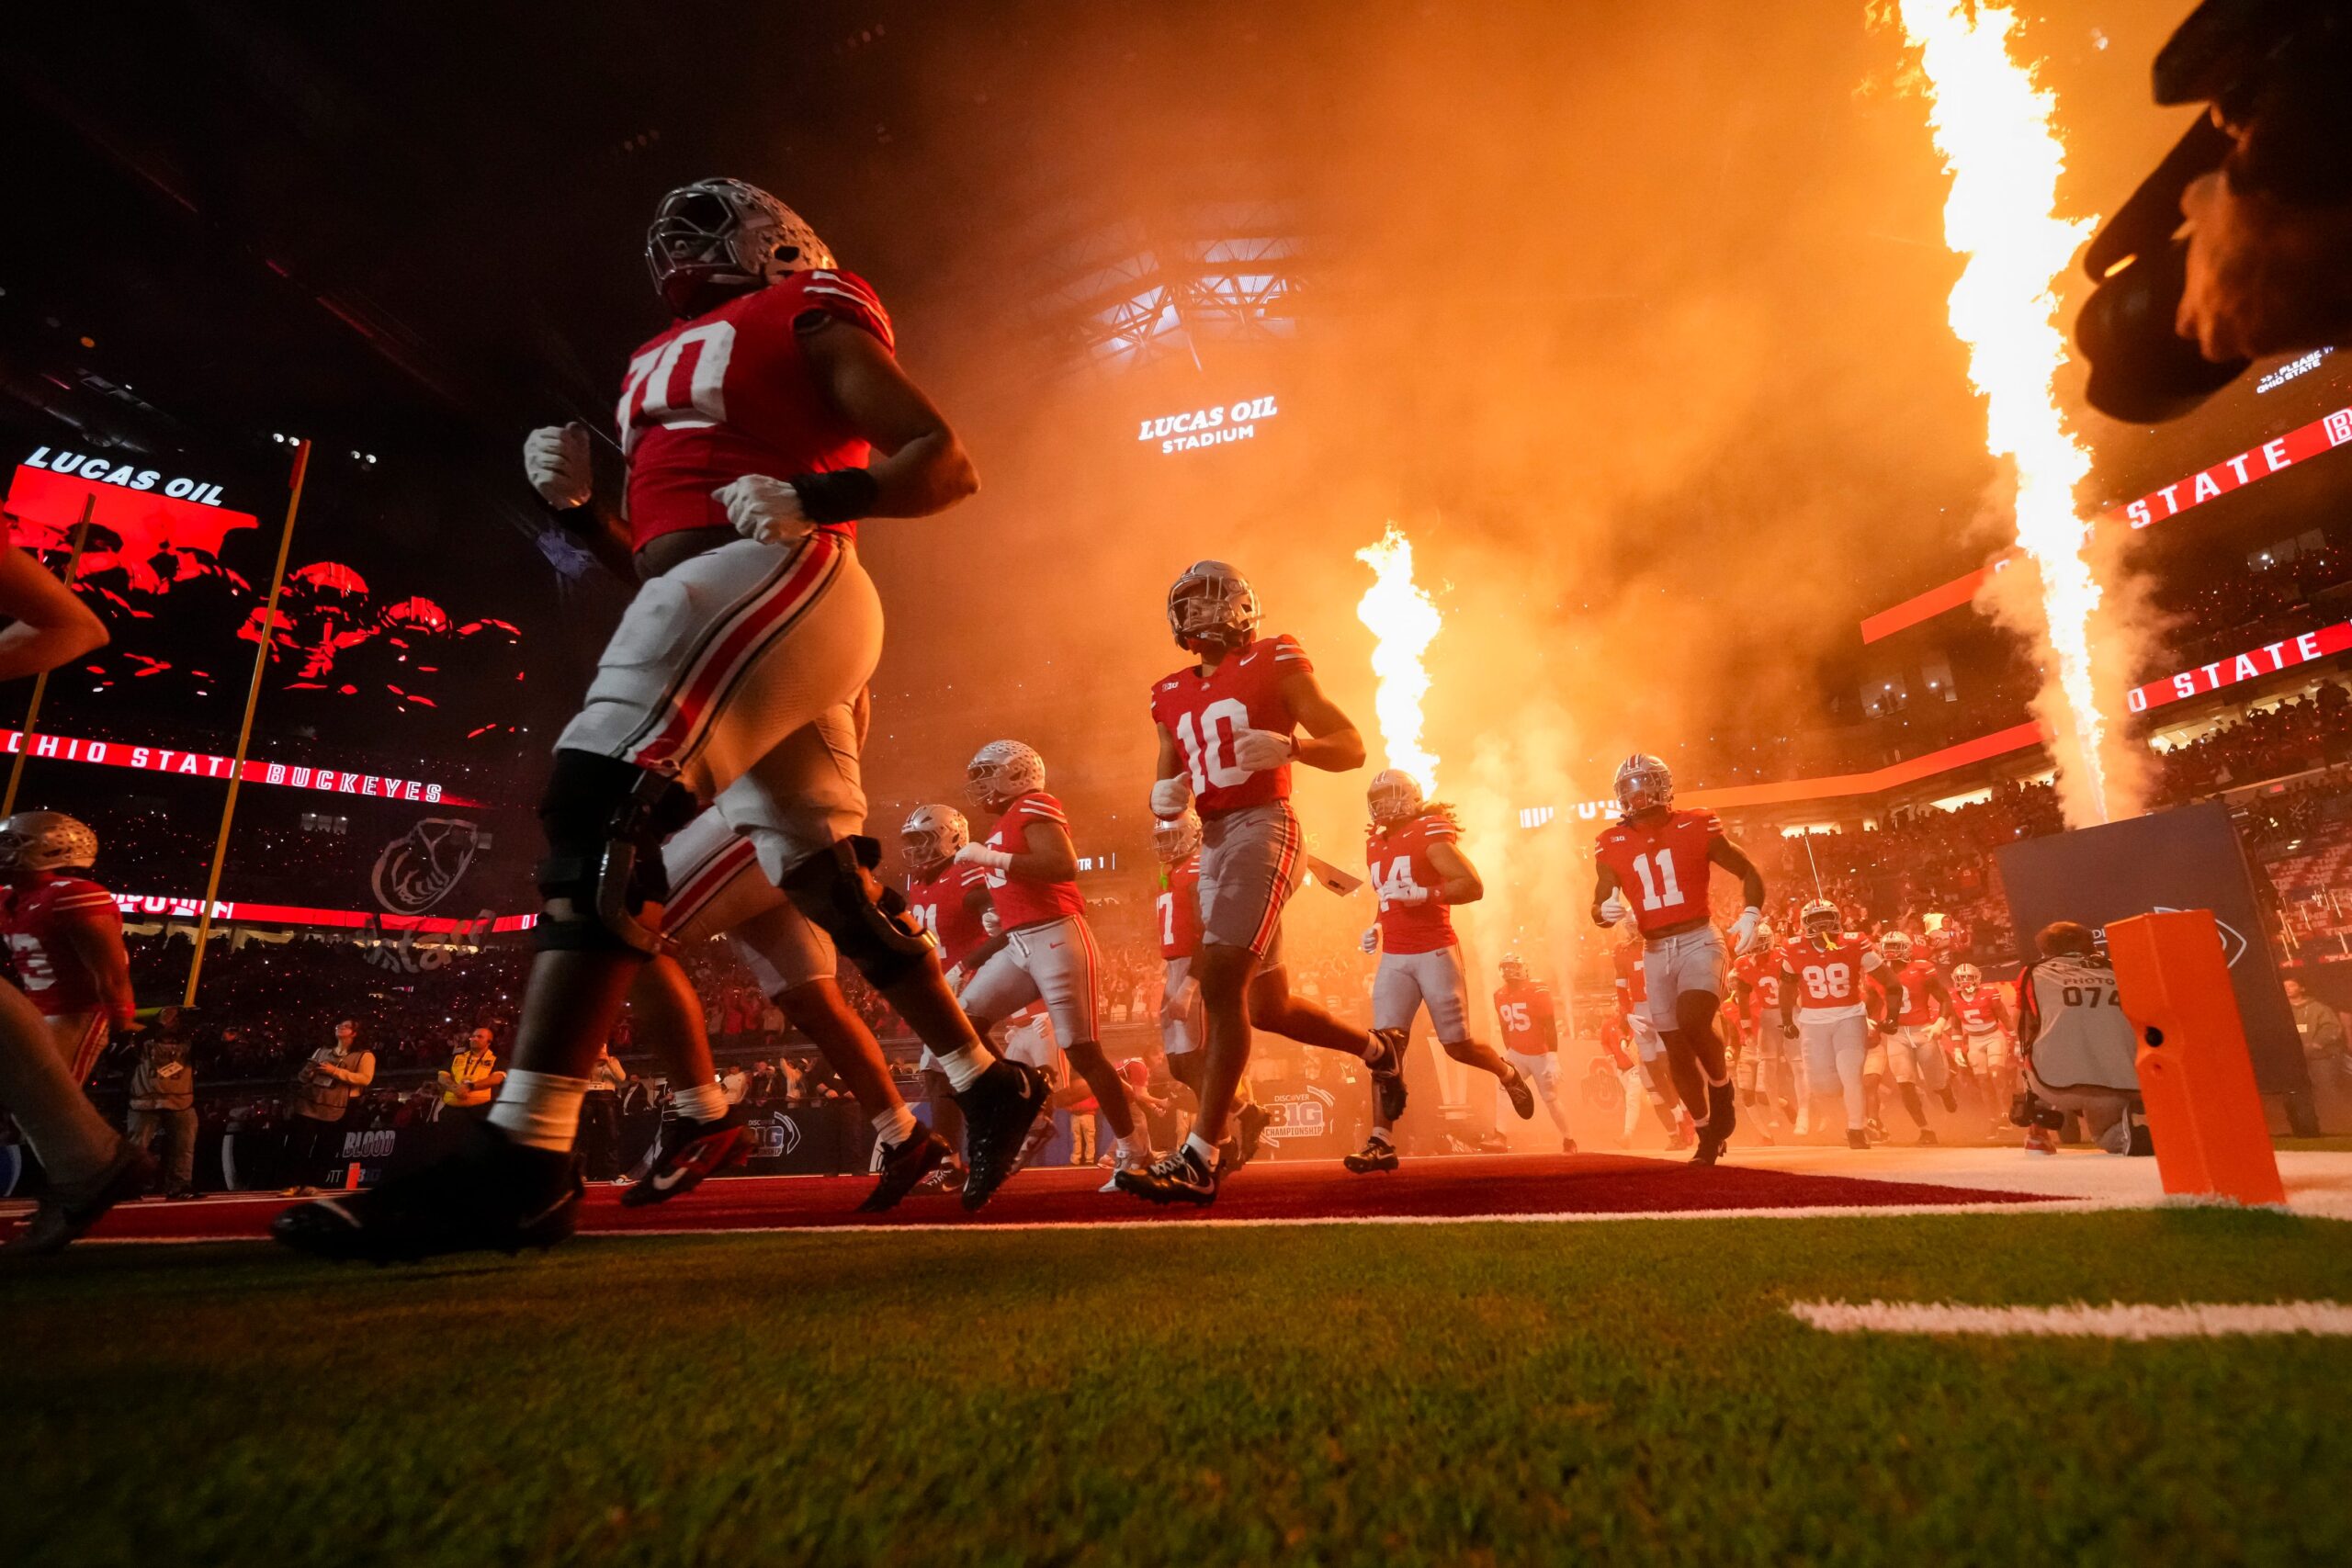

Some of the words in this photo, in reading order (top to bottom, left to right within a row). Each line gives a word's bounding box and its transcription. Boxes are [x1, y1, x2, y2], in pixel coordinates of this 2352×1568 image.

[1138, 406, 1224, 440] LUCAS
[1231, 396, 1277, 422] OIL
[1162, 424, 1254, 454] STADIUM
[24, 446, 161, 491] LUCAS
[164, 478, 223, 506] OIL
[2126, 437, 2291, 530] STATE
[2173, 632, 2322, 698] STATE
[1176, 697, 1254, 796] 10
[266, 763, 442, 803] BUCKEYES
[1099, 856, 1104, 869] 1
[1633, 848, 1685, 911] 11
[2064, 977, 2115, 986] PHOTO
[1499, 1002, 1531, 1032] 95
[343, 1130, 396, 1157] BLOOD
[1265, 1127, 1323, 1137] CHAMPIONSHIP
